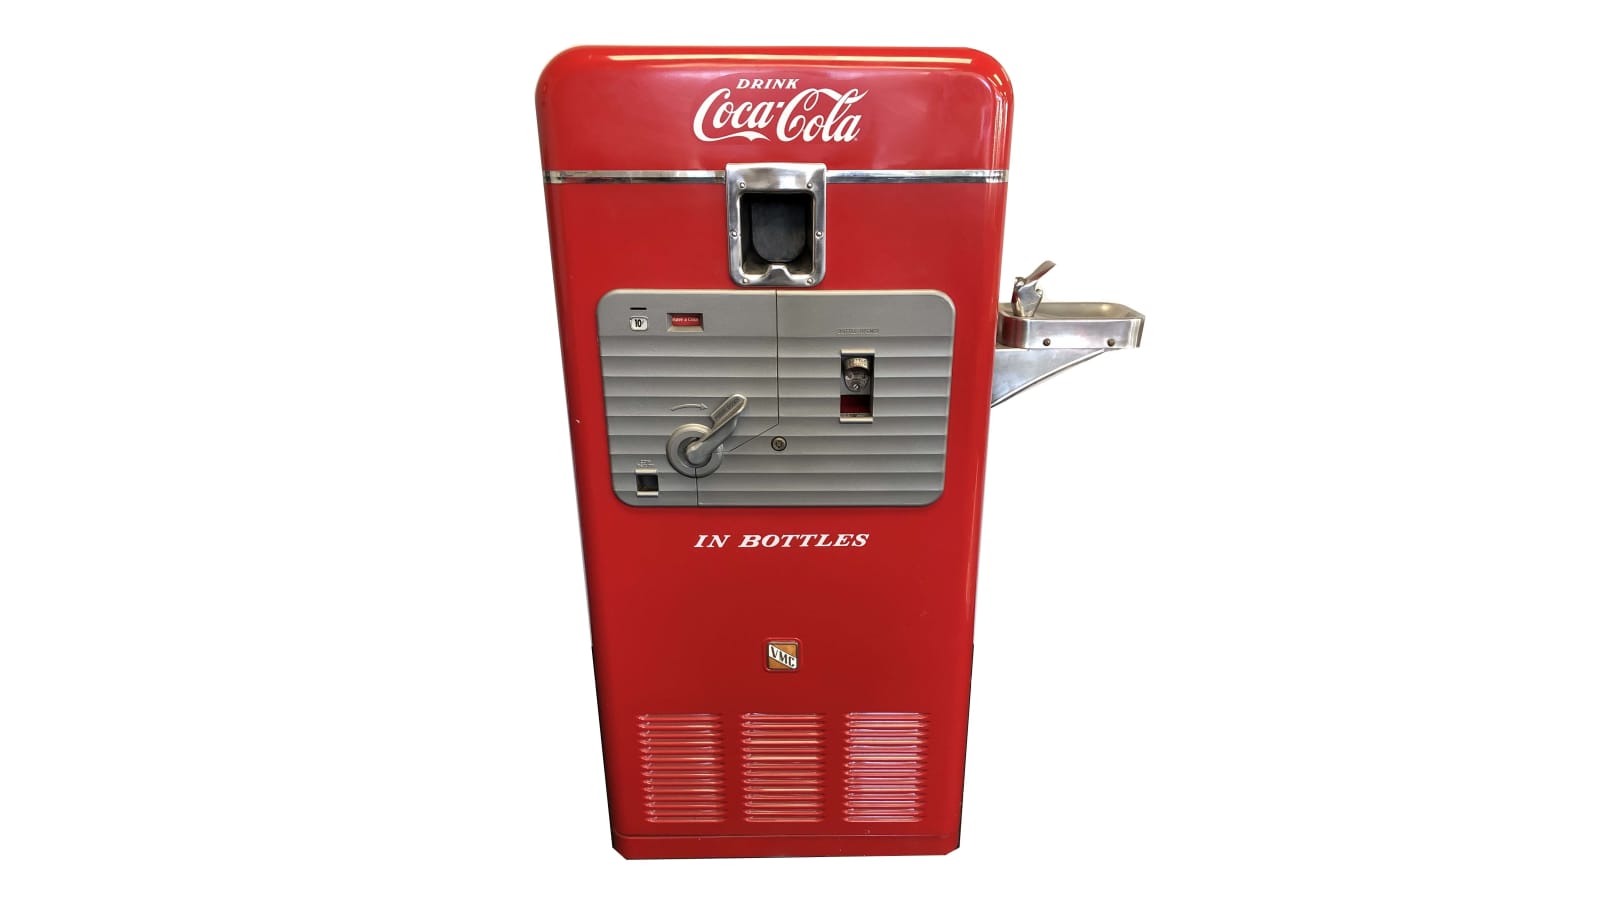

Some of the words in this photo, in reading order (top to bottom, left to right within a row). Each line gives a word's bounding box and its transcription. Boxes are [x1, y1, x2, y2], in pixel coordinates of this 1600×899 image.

[736, 78, 800, 90] DRINK
[692, 87, 870, 142] Coca-Cola
[693, 534, 731, 548] IN
[737, 533, 870, 548] BOTTLES
[770, 646, 795, 667] VMC
